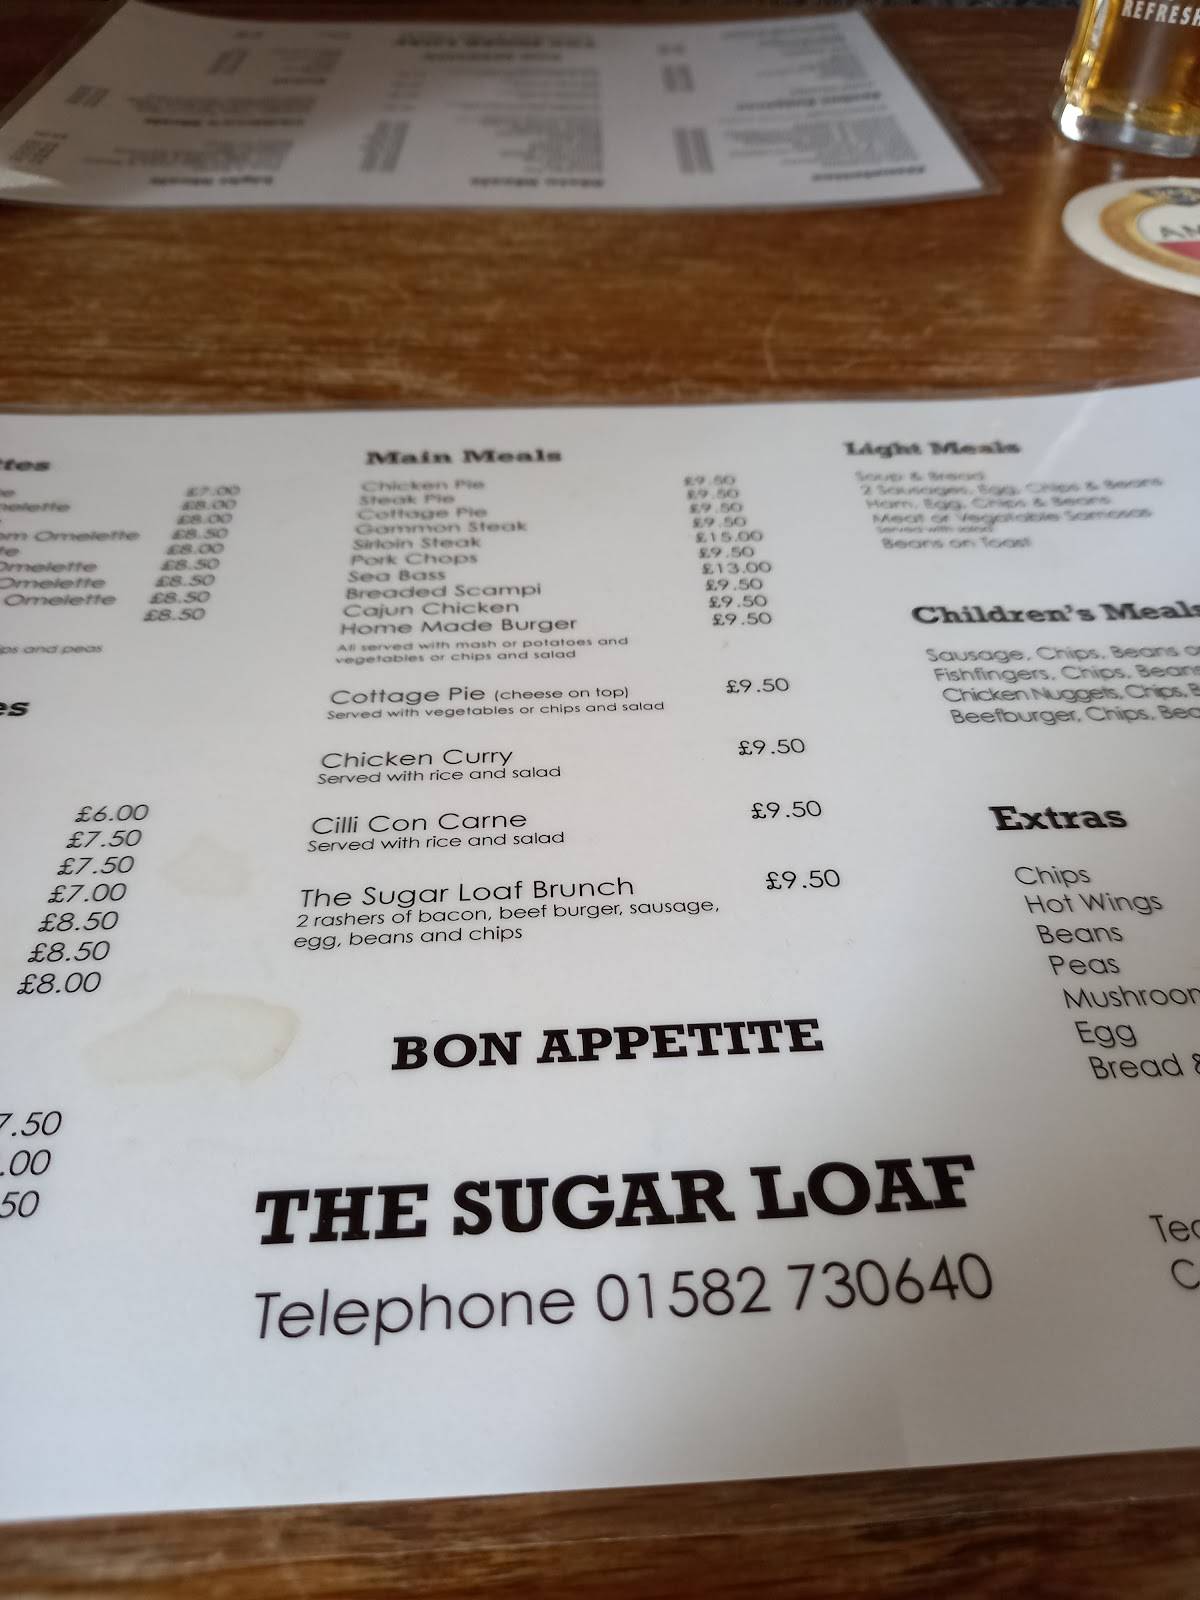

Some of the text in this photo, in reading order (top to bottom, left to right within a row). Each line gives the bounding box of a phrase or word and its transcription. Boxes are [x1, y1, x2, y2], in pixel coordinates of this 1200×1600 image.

[365, 448, 562, 465] Main Meals
[844, 441, 1022, 458] Light Meals
[186, 485, 241, 497] £7.00
[361, 478, 485, 492] Chicken Pie
[181, 500, 237, 511] £8.00
[359, 492, 455, 506] Steak Pie
[357, 506, 488, 521] Cottage Pie
[690, 502, 743, 514] £9.50
[177, 513, 233, 525] £8.00
[693, 516, 746, 528] £9.50
[35, 530, 140, 542] Omelette
[172, 528, 229, 541] £8.50
[355, 520, 527, 536] Gammon Steak
[696, 530, 763, 543] £15.00
[166, 543, 225, 556] £8.00
[352, 536, 481, 551] Sirloin Steak
[699, 546, 754, 558] £9.50
[161, 558, 220, 572] £8.50
[350, 552, 478, 566] Pork Chops
[348, 569, 446, 583] Sea Bass
[702, 561, 771, 575] £13.00
[155, 574, 215, 588] £8.50
[706, 578, 763, 591] £9.50
[5, 594, 117, 606] Omelette
[149, 591, 211, 605] £8.50
[346, 583, 541, 600] Breaded Scampi
[343, 599, 520, 619] Cajun Chicken
[709, 595, 767, 608] £9.50
[143, 608, 206, 622] £8.50
[712, 612, 772, 626] £9.50
[911, 601, 1200, 624] Children's Meals
[340, 617, 578, 636] Home Made Burger
[24, 646, 58, 655] and
[61, 645, 103, 656] peas
[337, 636, 629, 653] All served with mash or potatoes and
[1109, 645, 1179, 658] Beans
[335, 649, 577, 667] vegetables or chips and salad
[725, 677, 790, 694] £9.50
[330, 686, 629, 706] Cottage Pie (cheese on top)
[942, 687, 1030, 703] Chicken
[327, 701, 665, 720] Served with vegetables or chips and salad
[737, 738, 806, 756] £9.50
[321, 748, 513, 769] Chicken Curry
[317, 765, 561, 785] Served with rice and salad
[74, 803, 150, 823] £6.00
[751, 800, 822, 820] £9.50
[987, 805, 1128, 832] Extras
[311, 812, 527, 835] Cilli Con Carne
[65, 829, 143, 849] £7.50
[307, 831, 565, 853] Served with rice and salad
[56, 855, 135, 876] £7.50
[765, 868, 841, 891] £9.50
[1014, 865, 1092, 889] Chips
[47, 882, 127, 904] £7.00
[300, 876, 634, 909] The Sugar Loaf Brunch
[1023, 892, 1164, 916] Hot Wings
[37, 910, 119, 933] £8.50
[296, 901, 719, 928] 2 rashers of bacon, beef burger, sausage,
[293, 925, 523, 951] egg, beans and chips
[1035, 924, 1124, 945] Beans
[27, 940, 111, 963] £8.50
[1047, 954, 1121, 976] Peas
[16, 971, 102, 995] £8.00
[1074, 1020, 1138, 1049] Egg
[391, 1018, 825, 1071] BON APPETITE
[1087, 1052, 1185, 1080] Bread
[255, 1154, 976, 1246] THE SUGAR LOAF
[254, 1252, 993, 1346] Telephone 01582 730640
